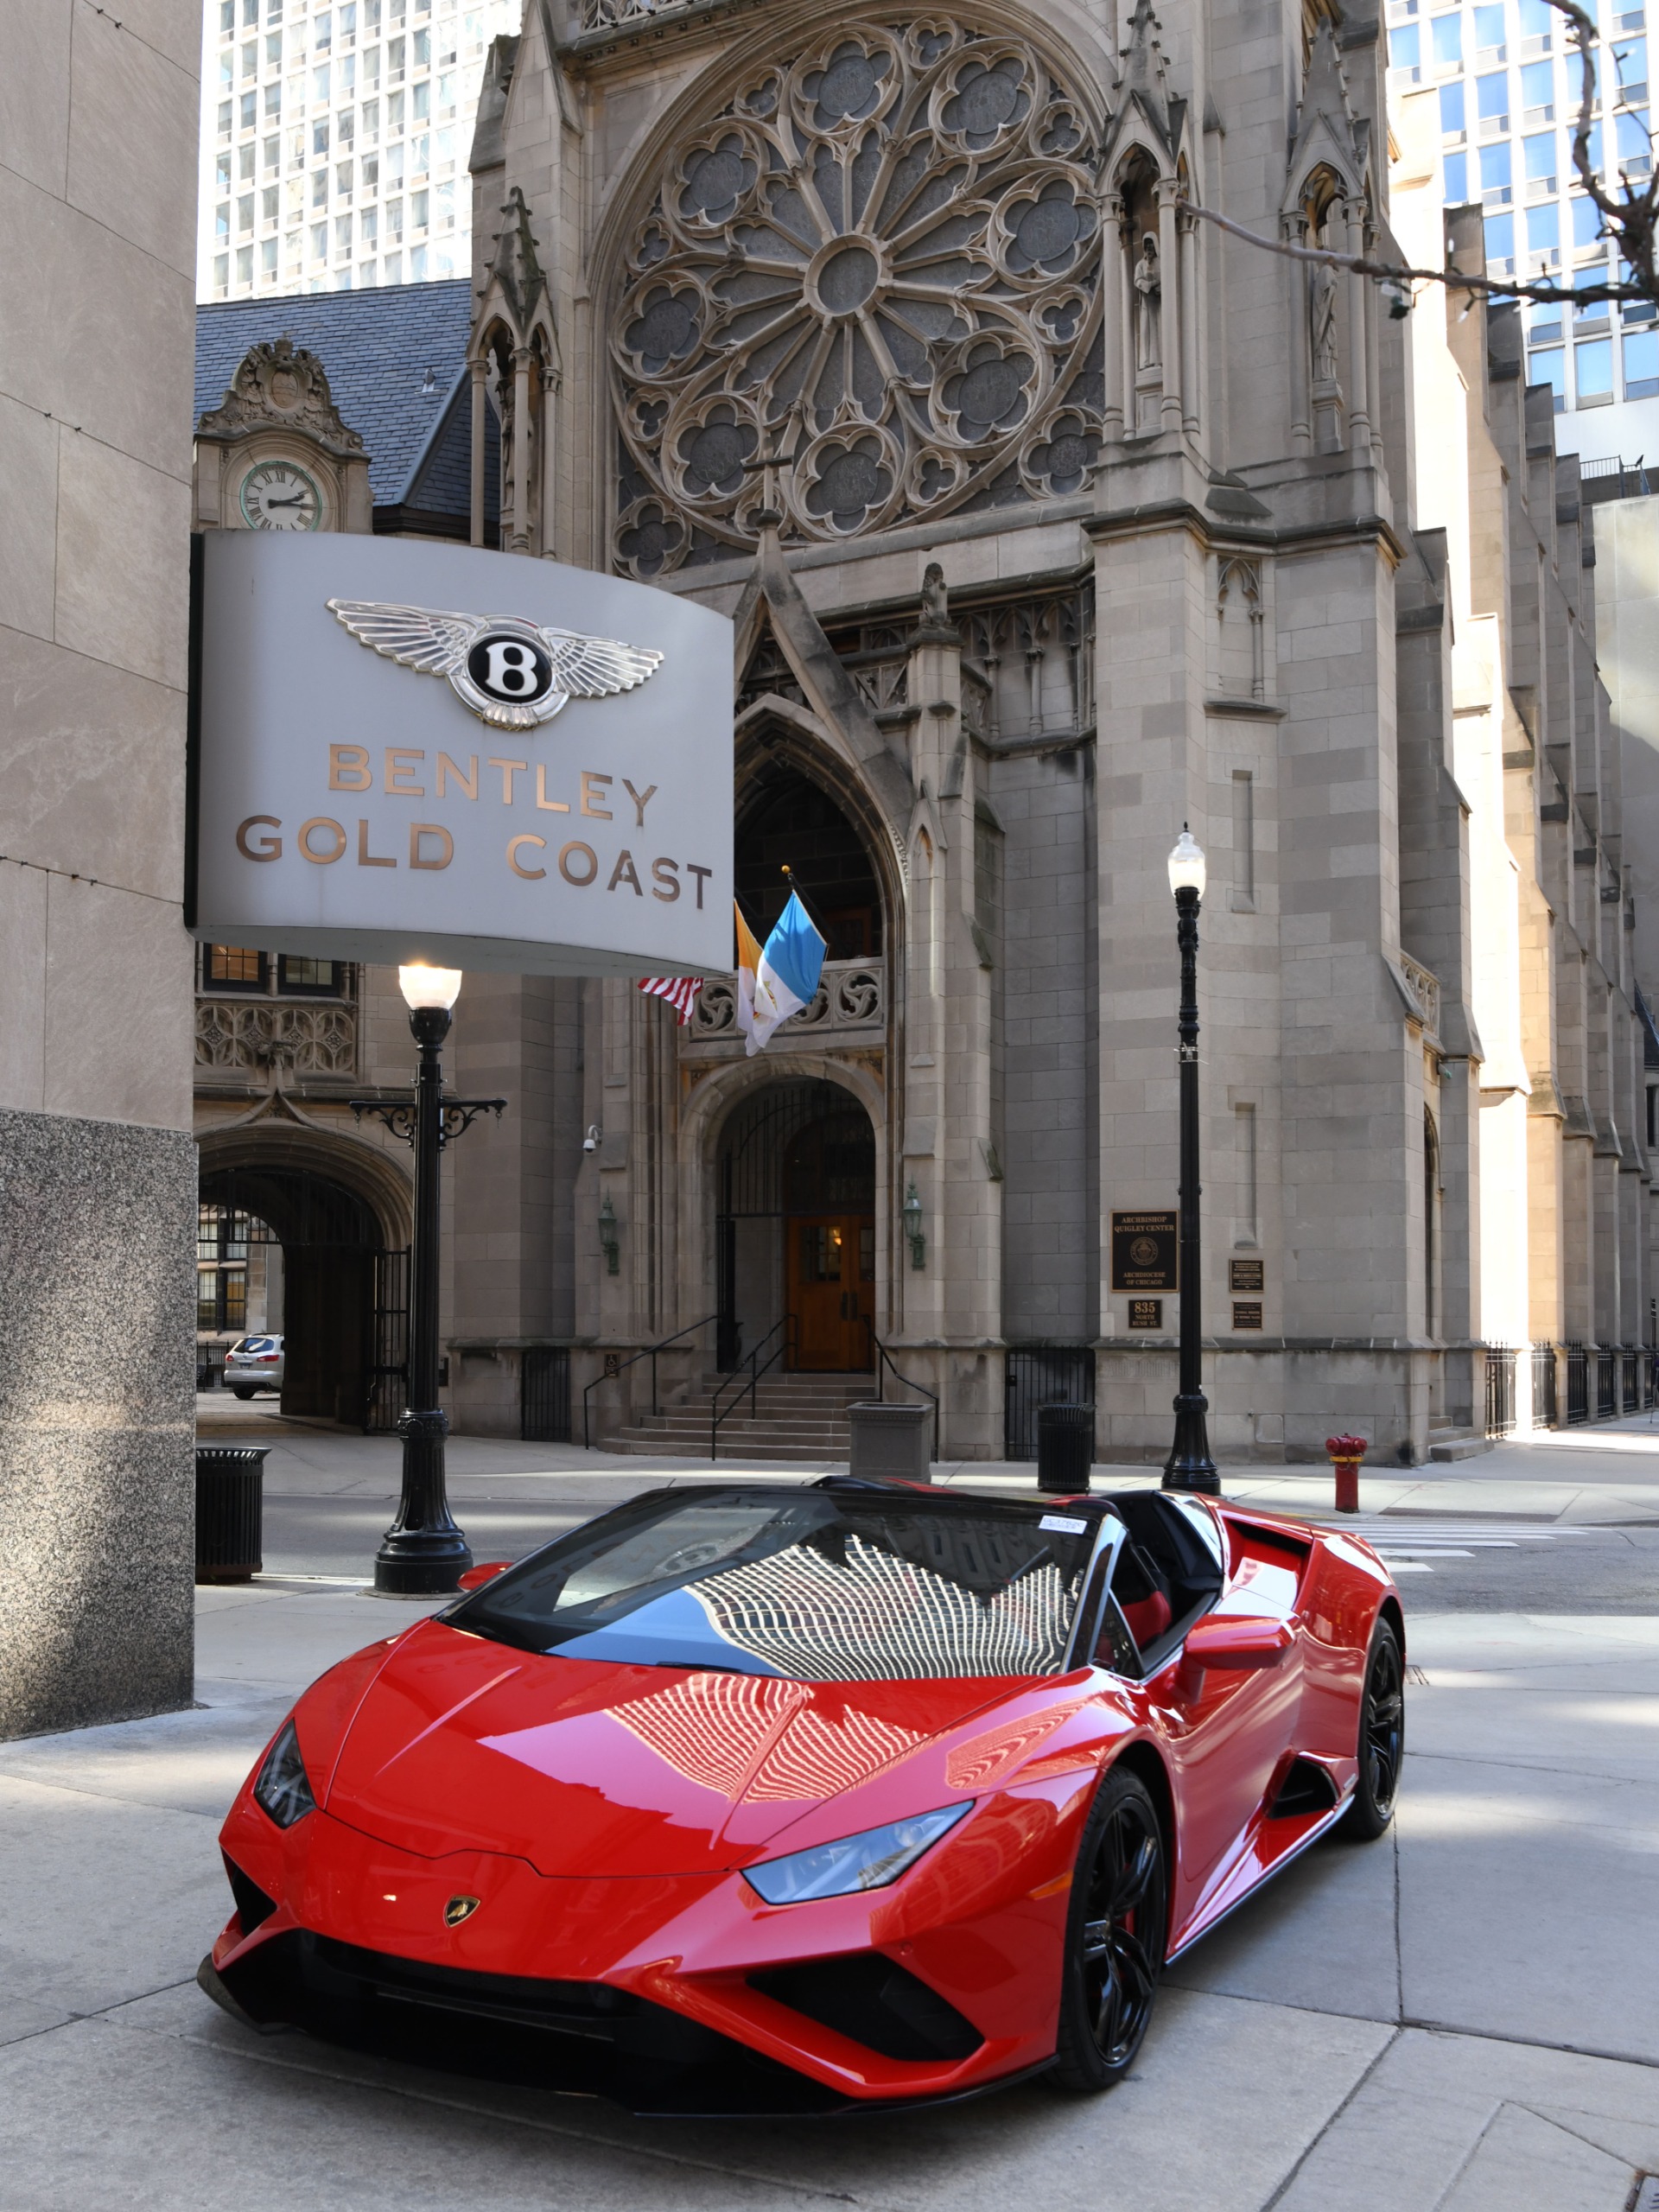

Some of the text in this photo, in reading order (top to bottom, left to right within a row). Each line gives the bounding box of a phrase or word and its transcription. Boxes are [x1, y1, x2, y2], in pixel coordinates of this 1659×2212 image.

[275, 470, 286, 484] XII
[486, 640, 537, 696] B
[328, 742, 658, 827] BENTLEY
[235, 814, 713, 910] GOLD COAST
[1134, 1301, 1156, 1313] 835
